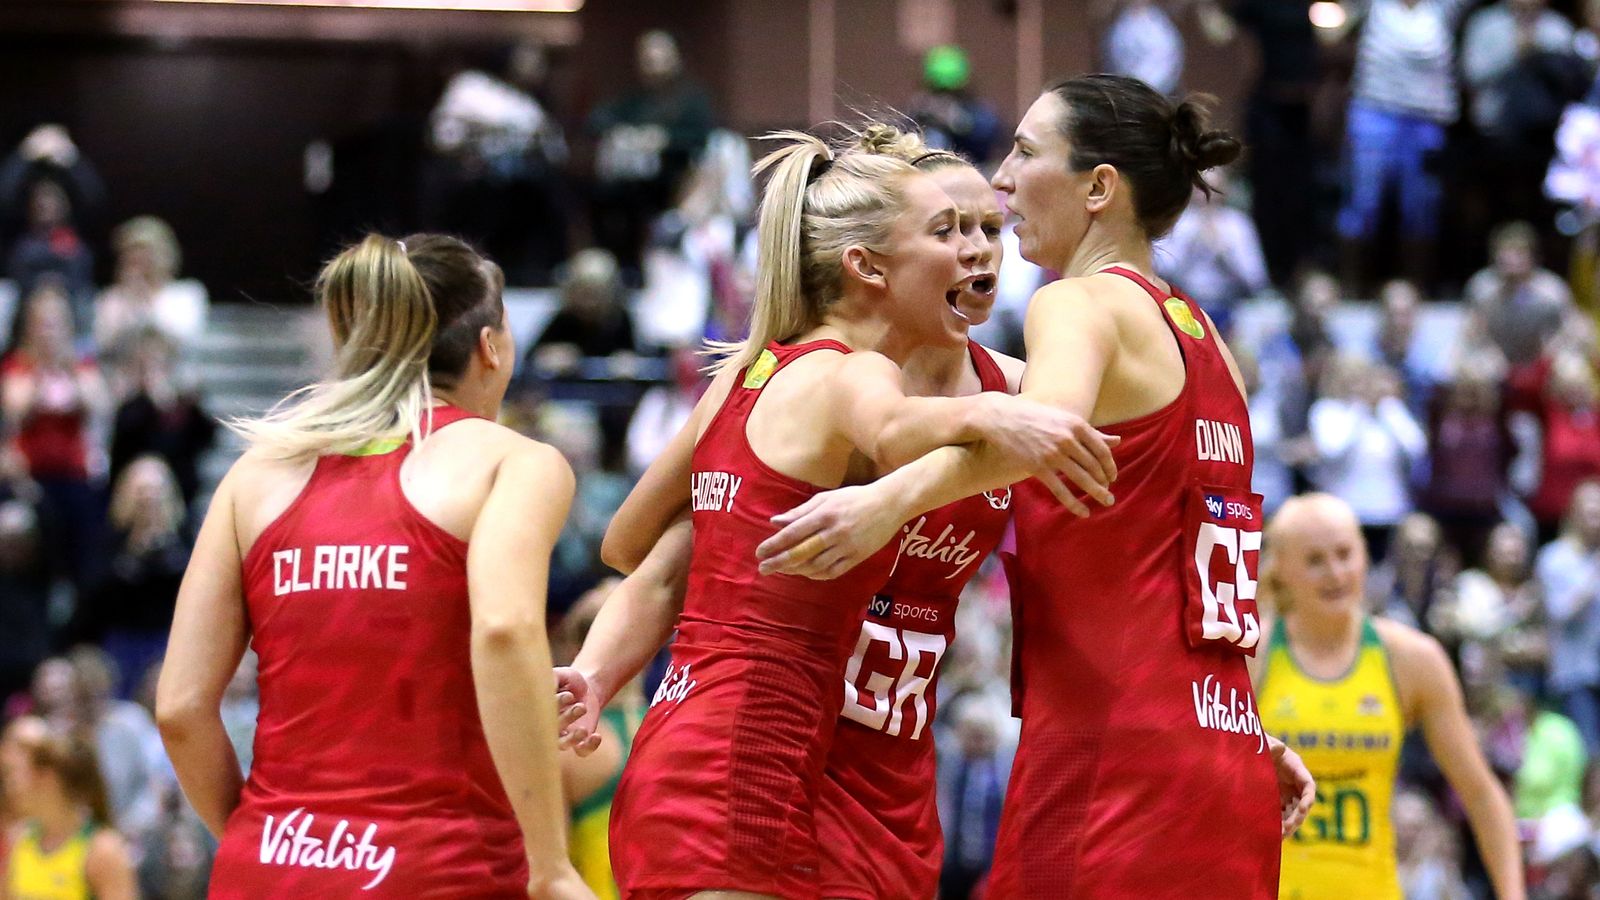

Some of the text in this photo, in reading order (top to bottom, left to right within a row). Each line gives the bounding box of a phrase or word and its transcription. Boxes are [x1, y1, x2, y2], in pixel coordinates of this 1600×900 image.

[1195, 418, 1245, 466] DUNN
[691, 471, 743, 513] HOUSBY
[1205, 496, 1223, 518] sky
[272, 544, 410, 597] CLARKE
[900, 515, 980, 580] itality
[868, 595, 939, 622] ky sports
[1195, 521, 1262, 649] GS
[839, 620, 947, 741] GA
[1192, 674, 1264, 755] Vitality
[259, 806, 396, 890] Vitality
